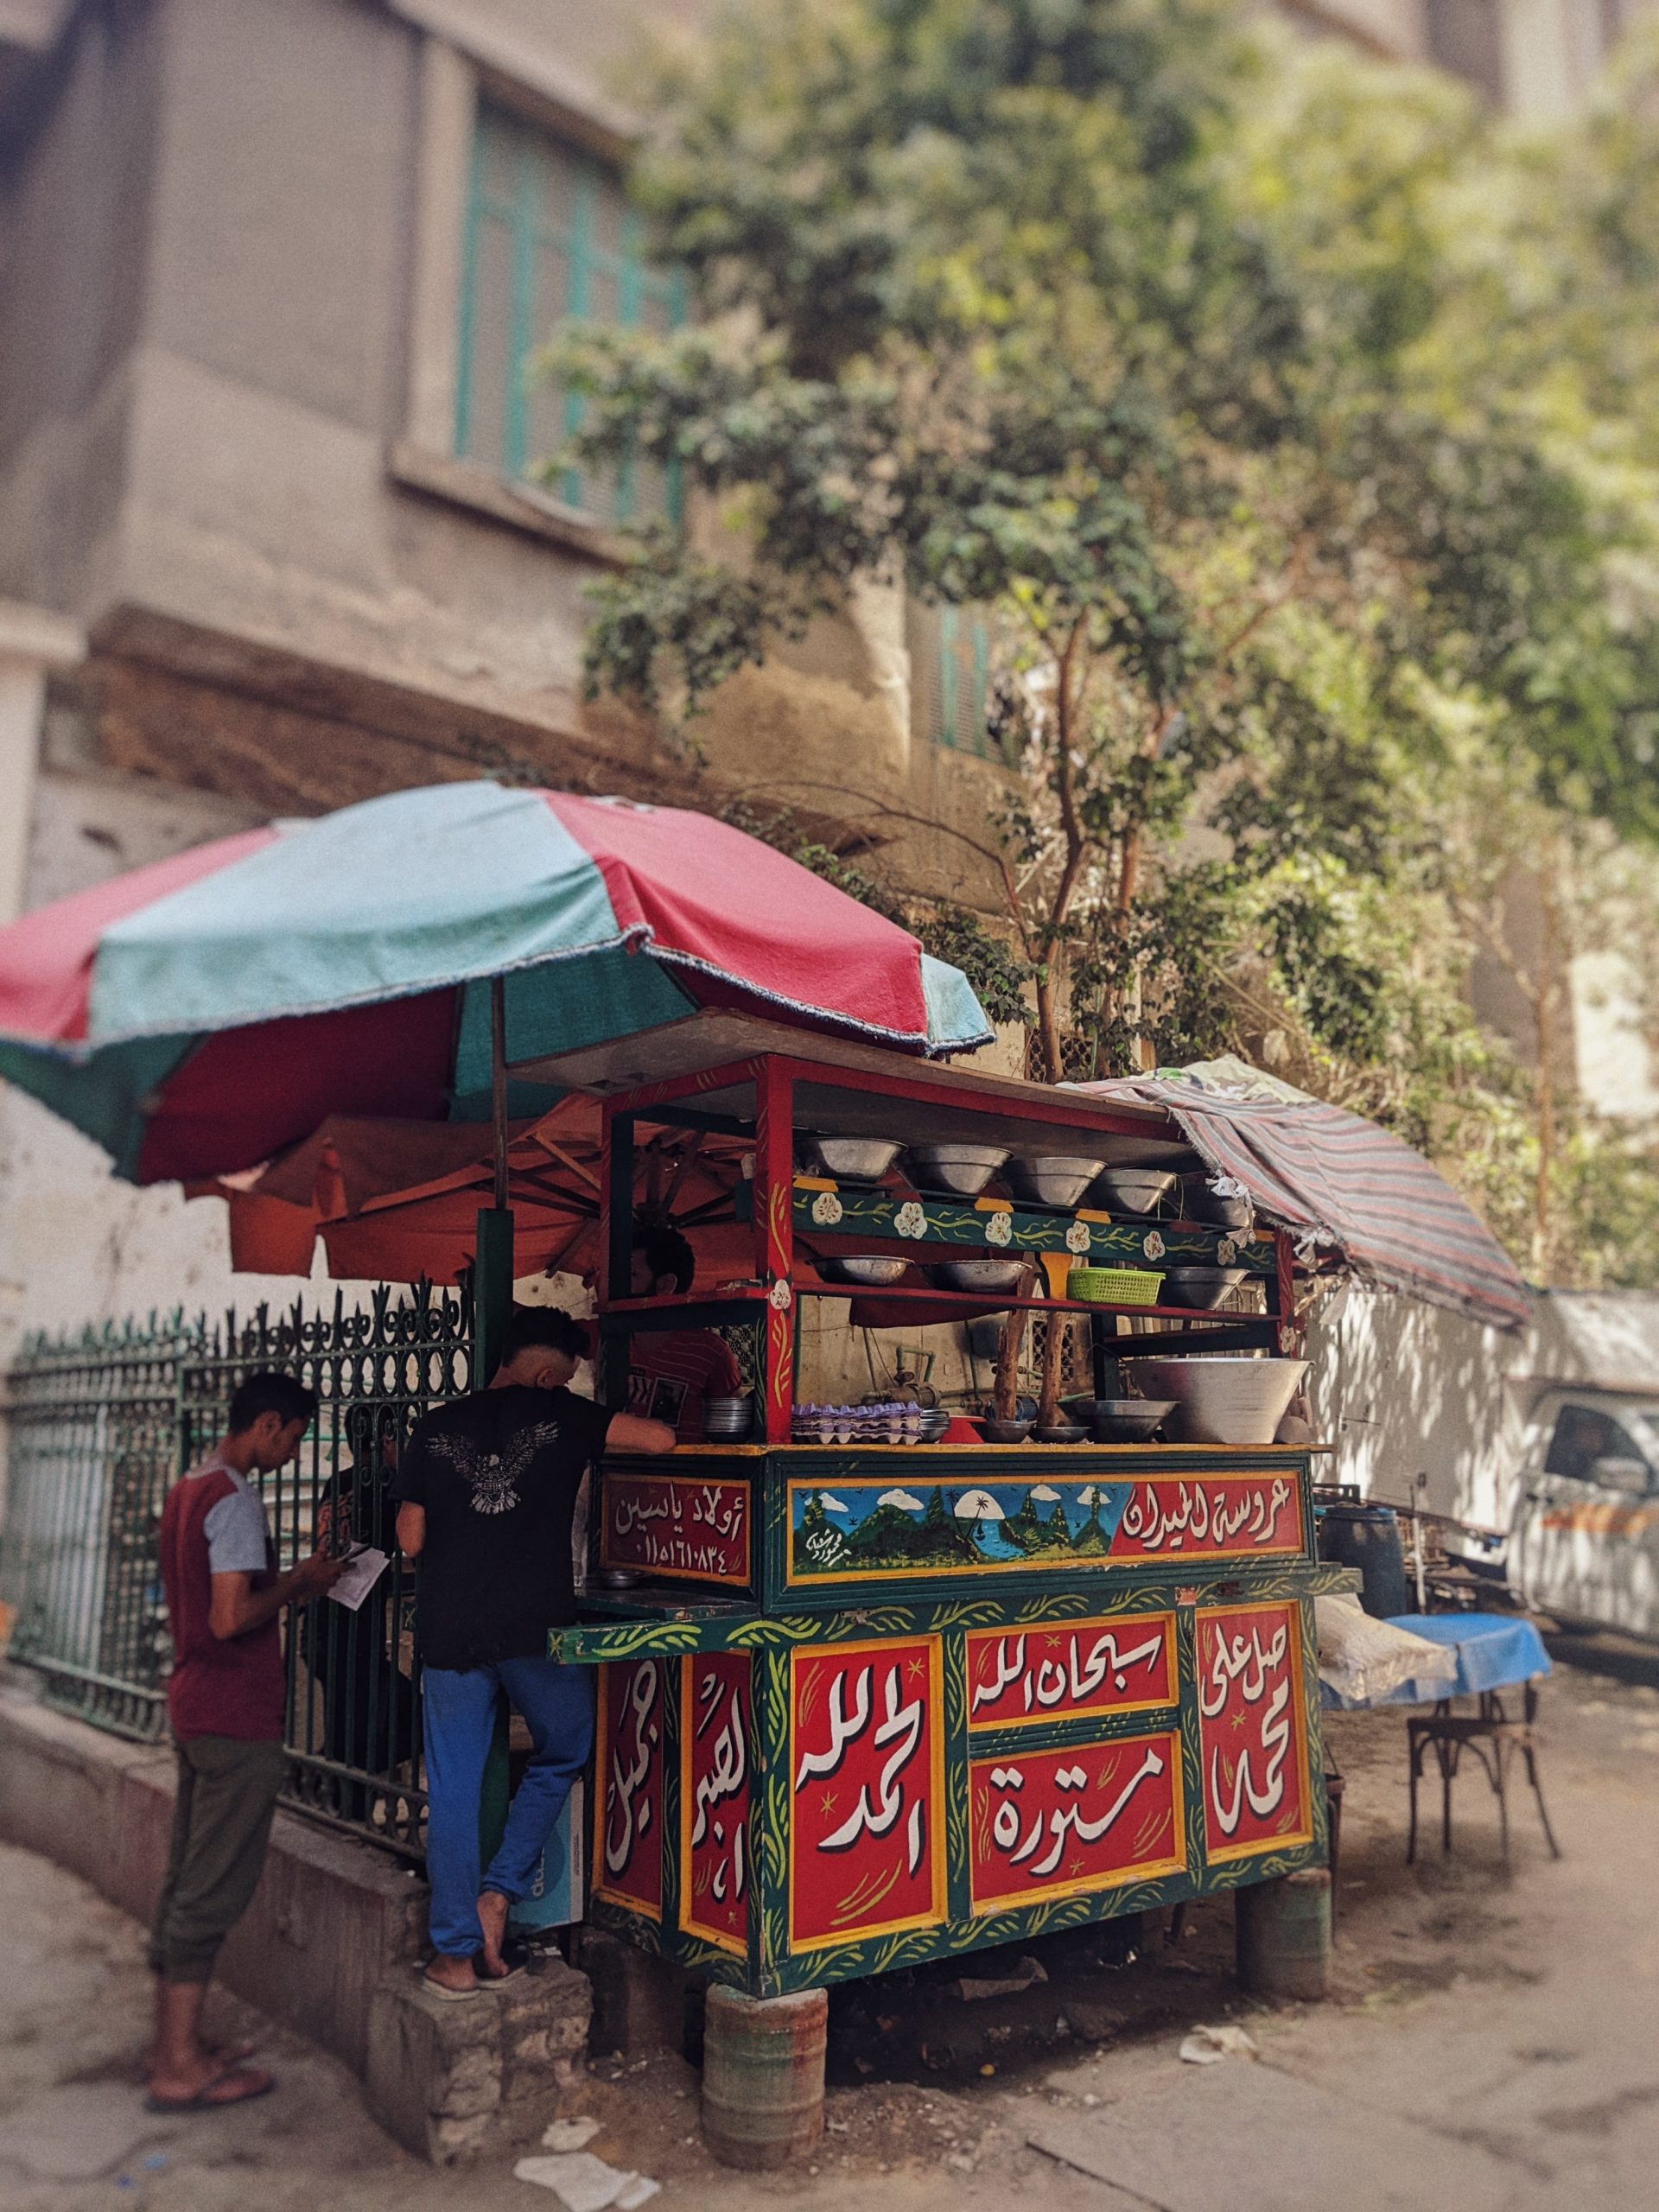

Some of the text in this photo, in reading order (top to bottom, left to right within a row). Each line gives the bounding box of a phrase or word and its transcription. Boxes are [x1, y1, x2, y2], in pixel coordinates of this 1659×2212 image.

[615, 1481, 744, 1542] أولاد ياسين
[1122, 1478, 1290, 1548] عروسة الميدان
[971, 1633, 1163, 1713] سبحان الله
[1201, 1623, 1287, 1716] صل على
[606, 1660, 657, 1872] جميل
[795, 1665, 922, 1874] الحمد لله
[990, 1748, 1163, 1875] مستورة
